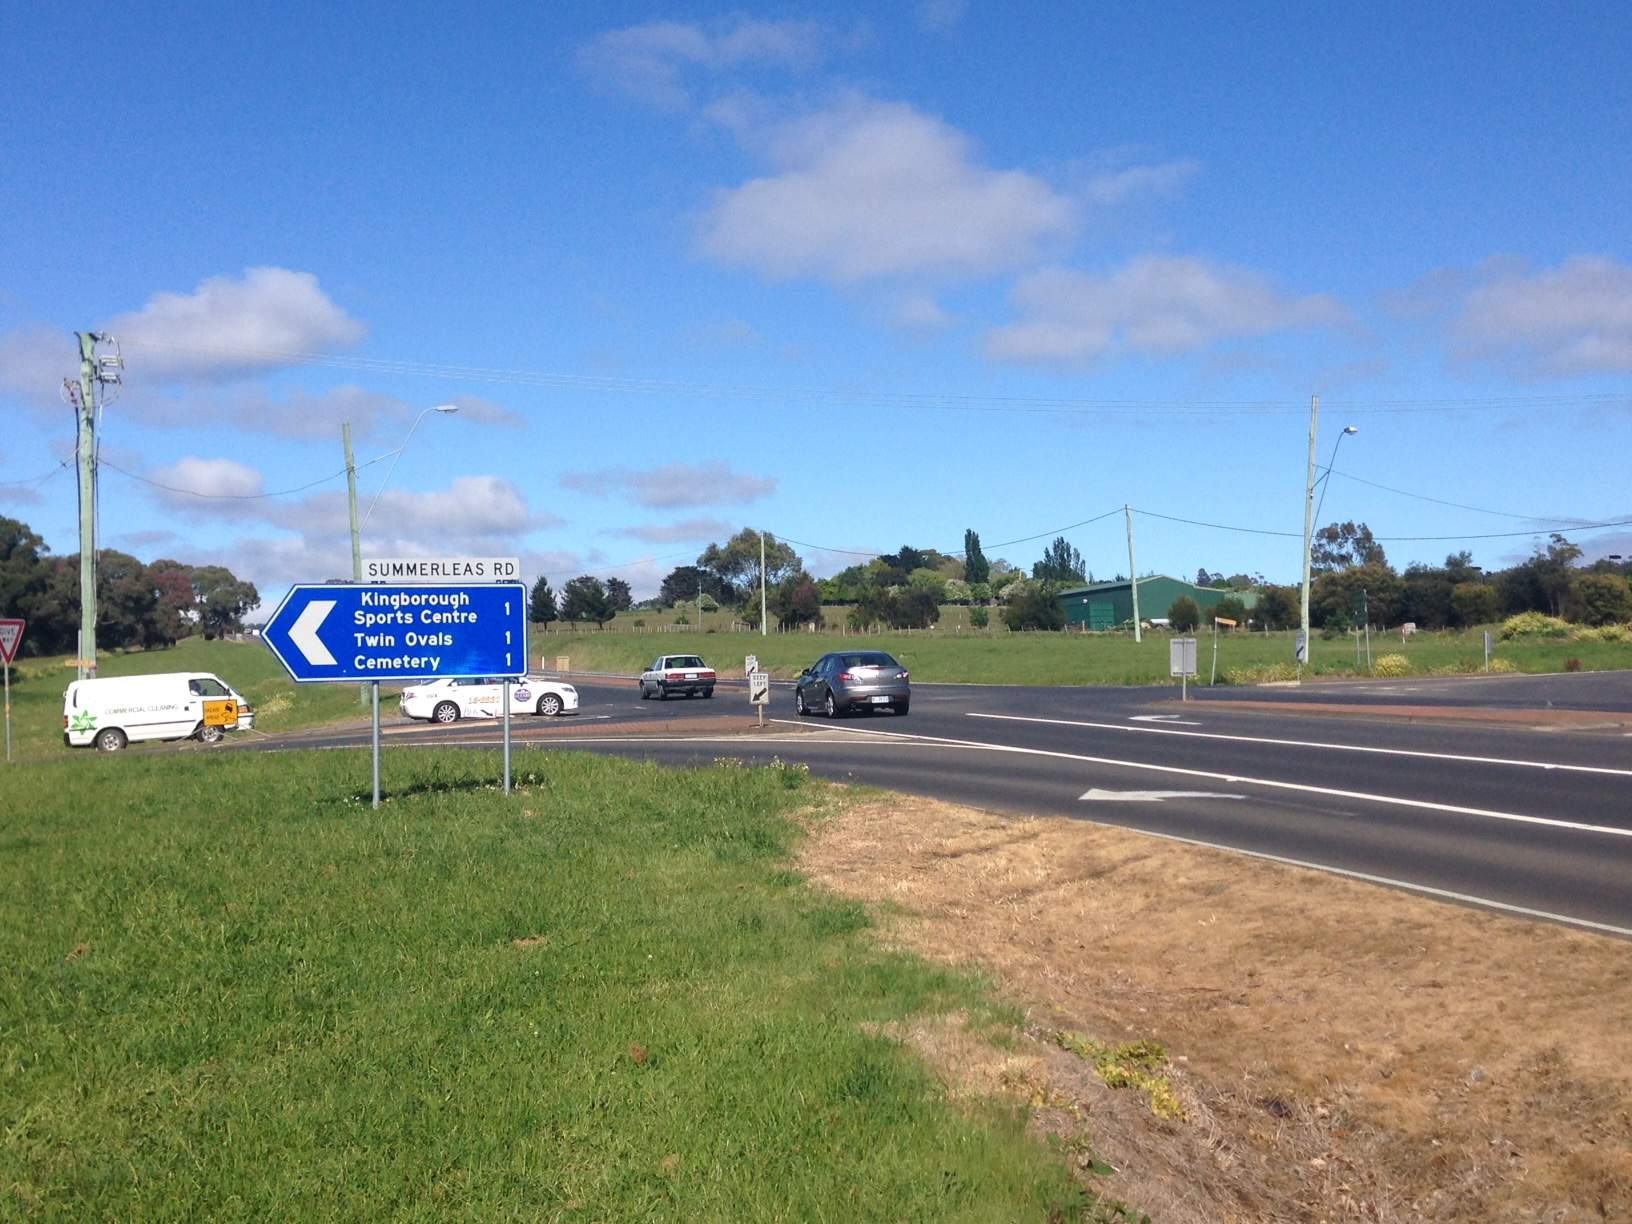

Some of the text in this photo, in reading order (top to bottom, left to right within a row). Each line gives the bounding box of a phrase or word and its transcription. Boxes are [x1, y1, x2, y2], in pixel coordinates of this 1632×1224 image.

[368, 562, 515, 577] SUMMERLEAS RD
[361, 591, 470, 610] Kingborough
[354, 601, 511, 627] Sports Centre 1
[354, 630, 511, 647] Twin Ovals 1
[354, 653, 512, 671] Cemetery 1
